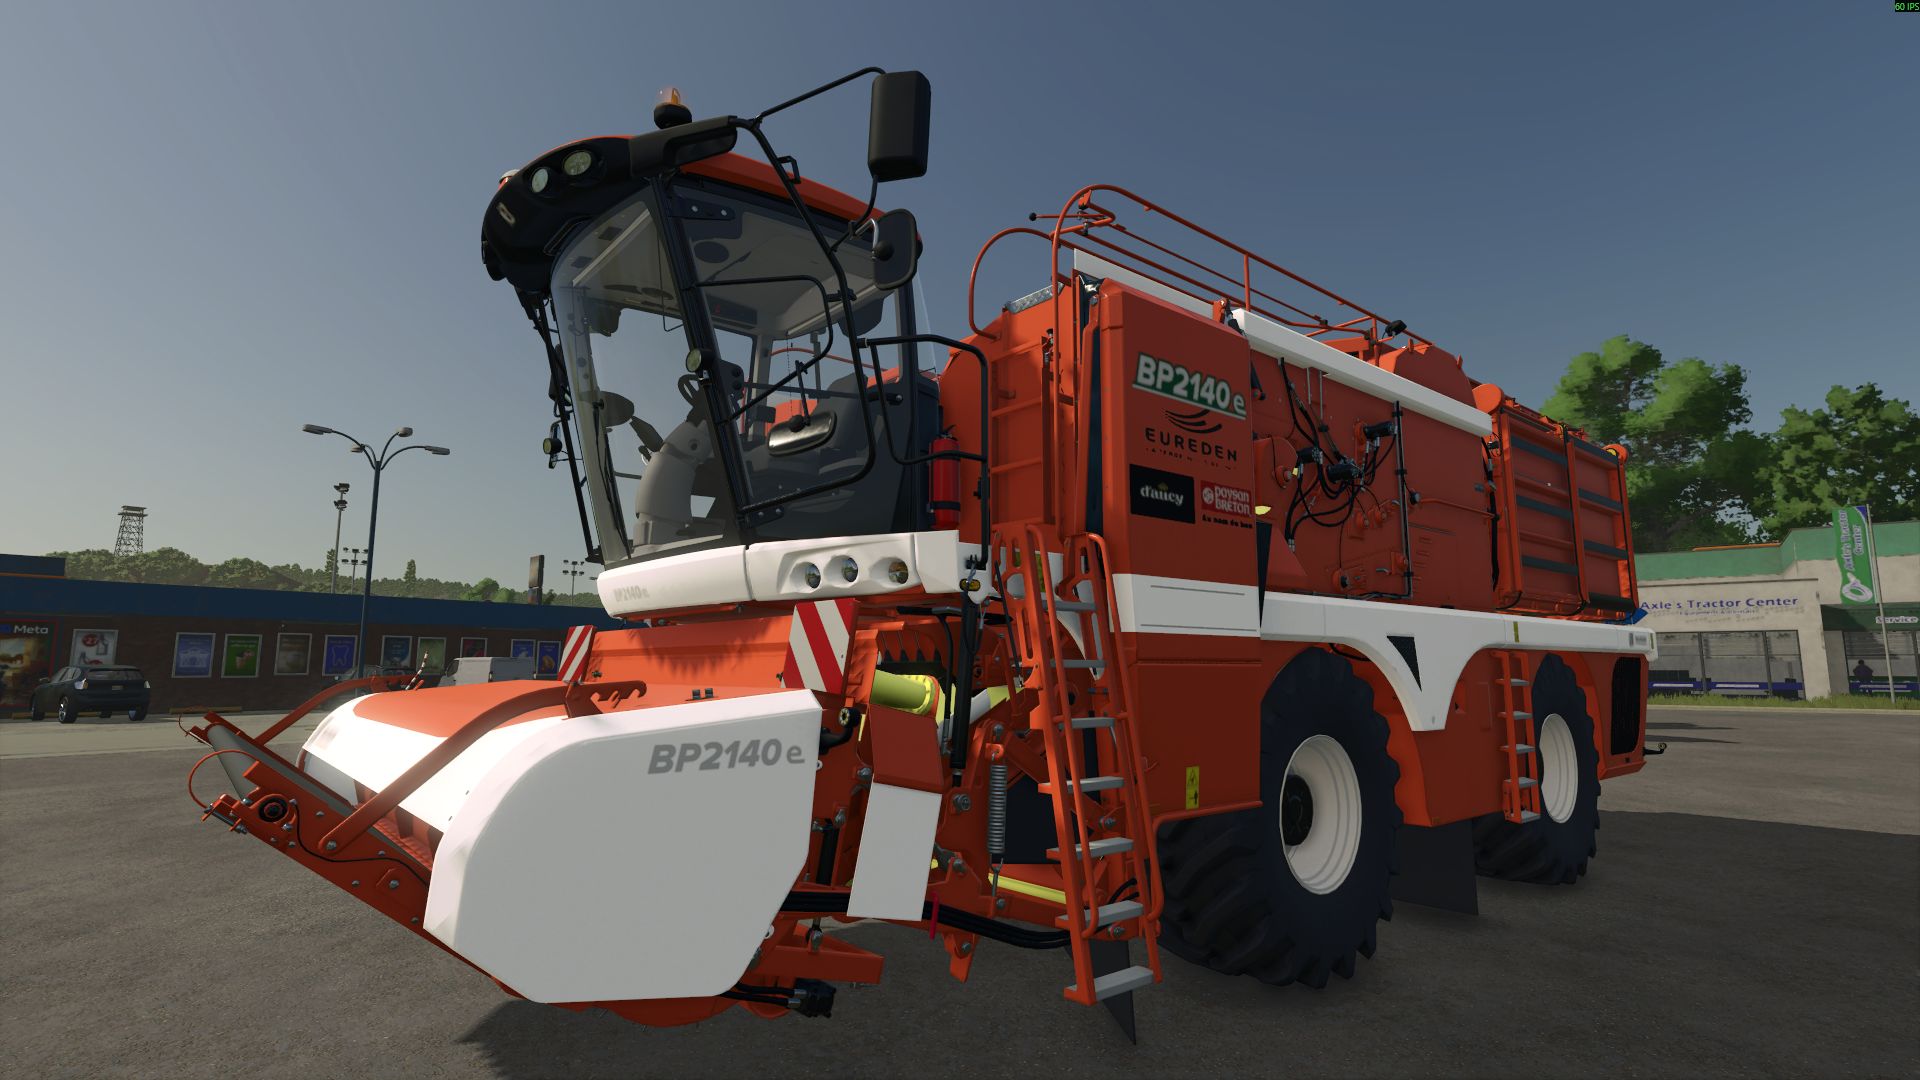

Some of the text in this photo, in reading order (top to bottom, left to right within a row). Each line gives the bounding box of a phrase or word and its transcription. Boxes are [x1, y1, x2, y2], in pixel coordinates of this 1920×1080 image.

[1145, 428, 1237, 461] EUREDEN
[1687, 599, 1741, 609] Tractor
[1745, 597, 1798, 607] Center
[1875, 615, 1919, 624] Service
